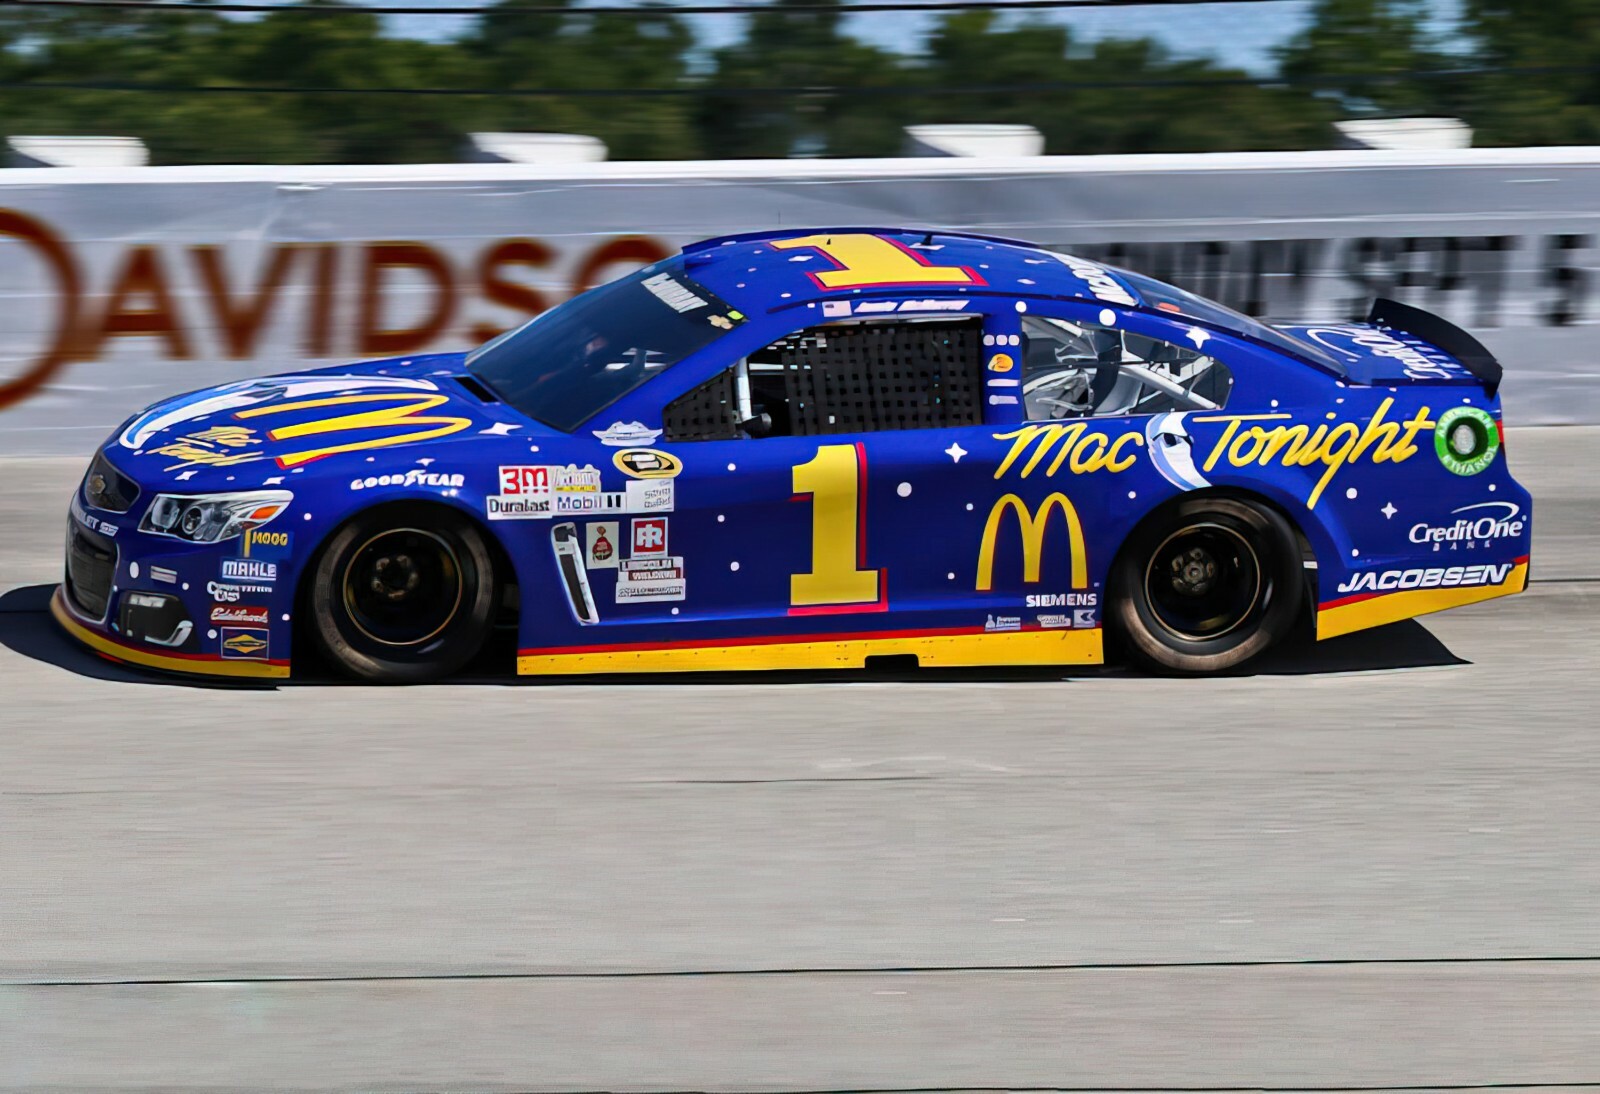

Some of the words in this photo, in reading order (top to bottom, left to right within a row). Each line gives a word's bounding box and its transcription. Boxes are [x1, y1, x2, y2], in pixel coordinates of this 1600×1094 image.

[769, 233, 985, 290] 1
[992, 422, 1144, 480] Mac
[1192, 397, 1435, 510] Tonight
[351, 470, 465, 490] GOODYEAR
[502, 468, 549, 494] 3M
[489, 498, 550, 513] Duralast
[558, 496, 602, 509] Mobil
[789, 443, 884, 611] 1
[1433, 540, 1491, 551] BANK
[222, 561, 276, 577] MAHLE
[1337, 564, 1508, 592] JACOBSEN
[1026, 594, 1097, 607] SIEMENS
